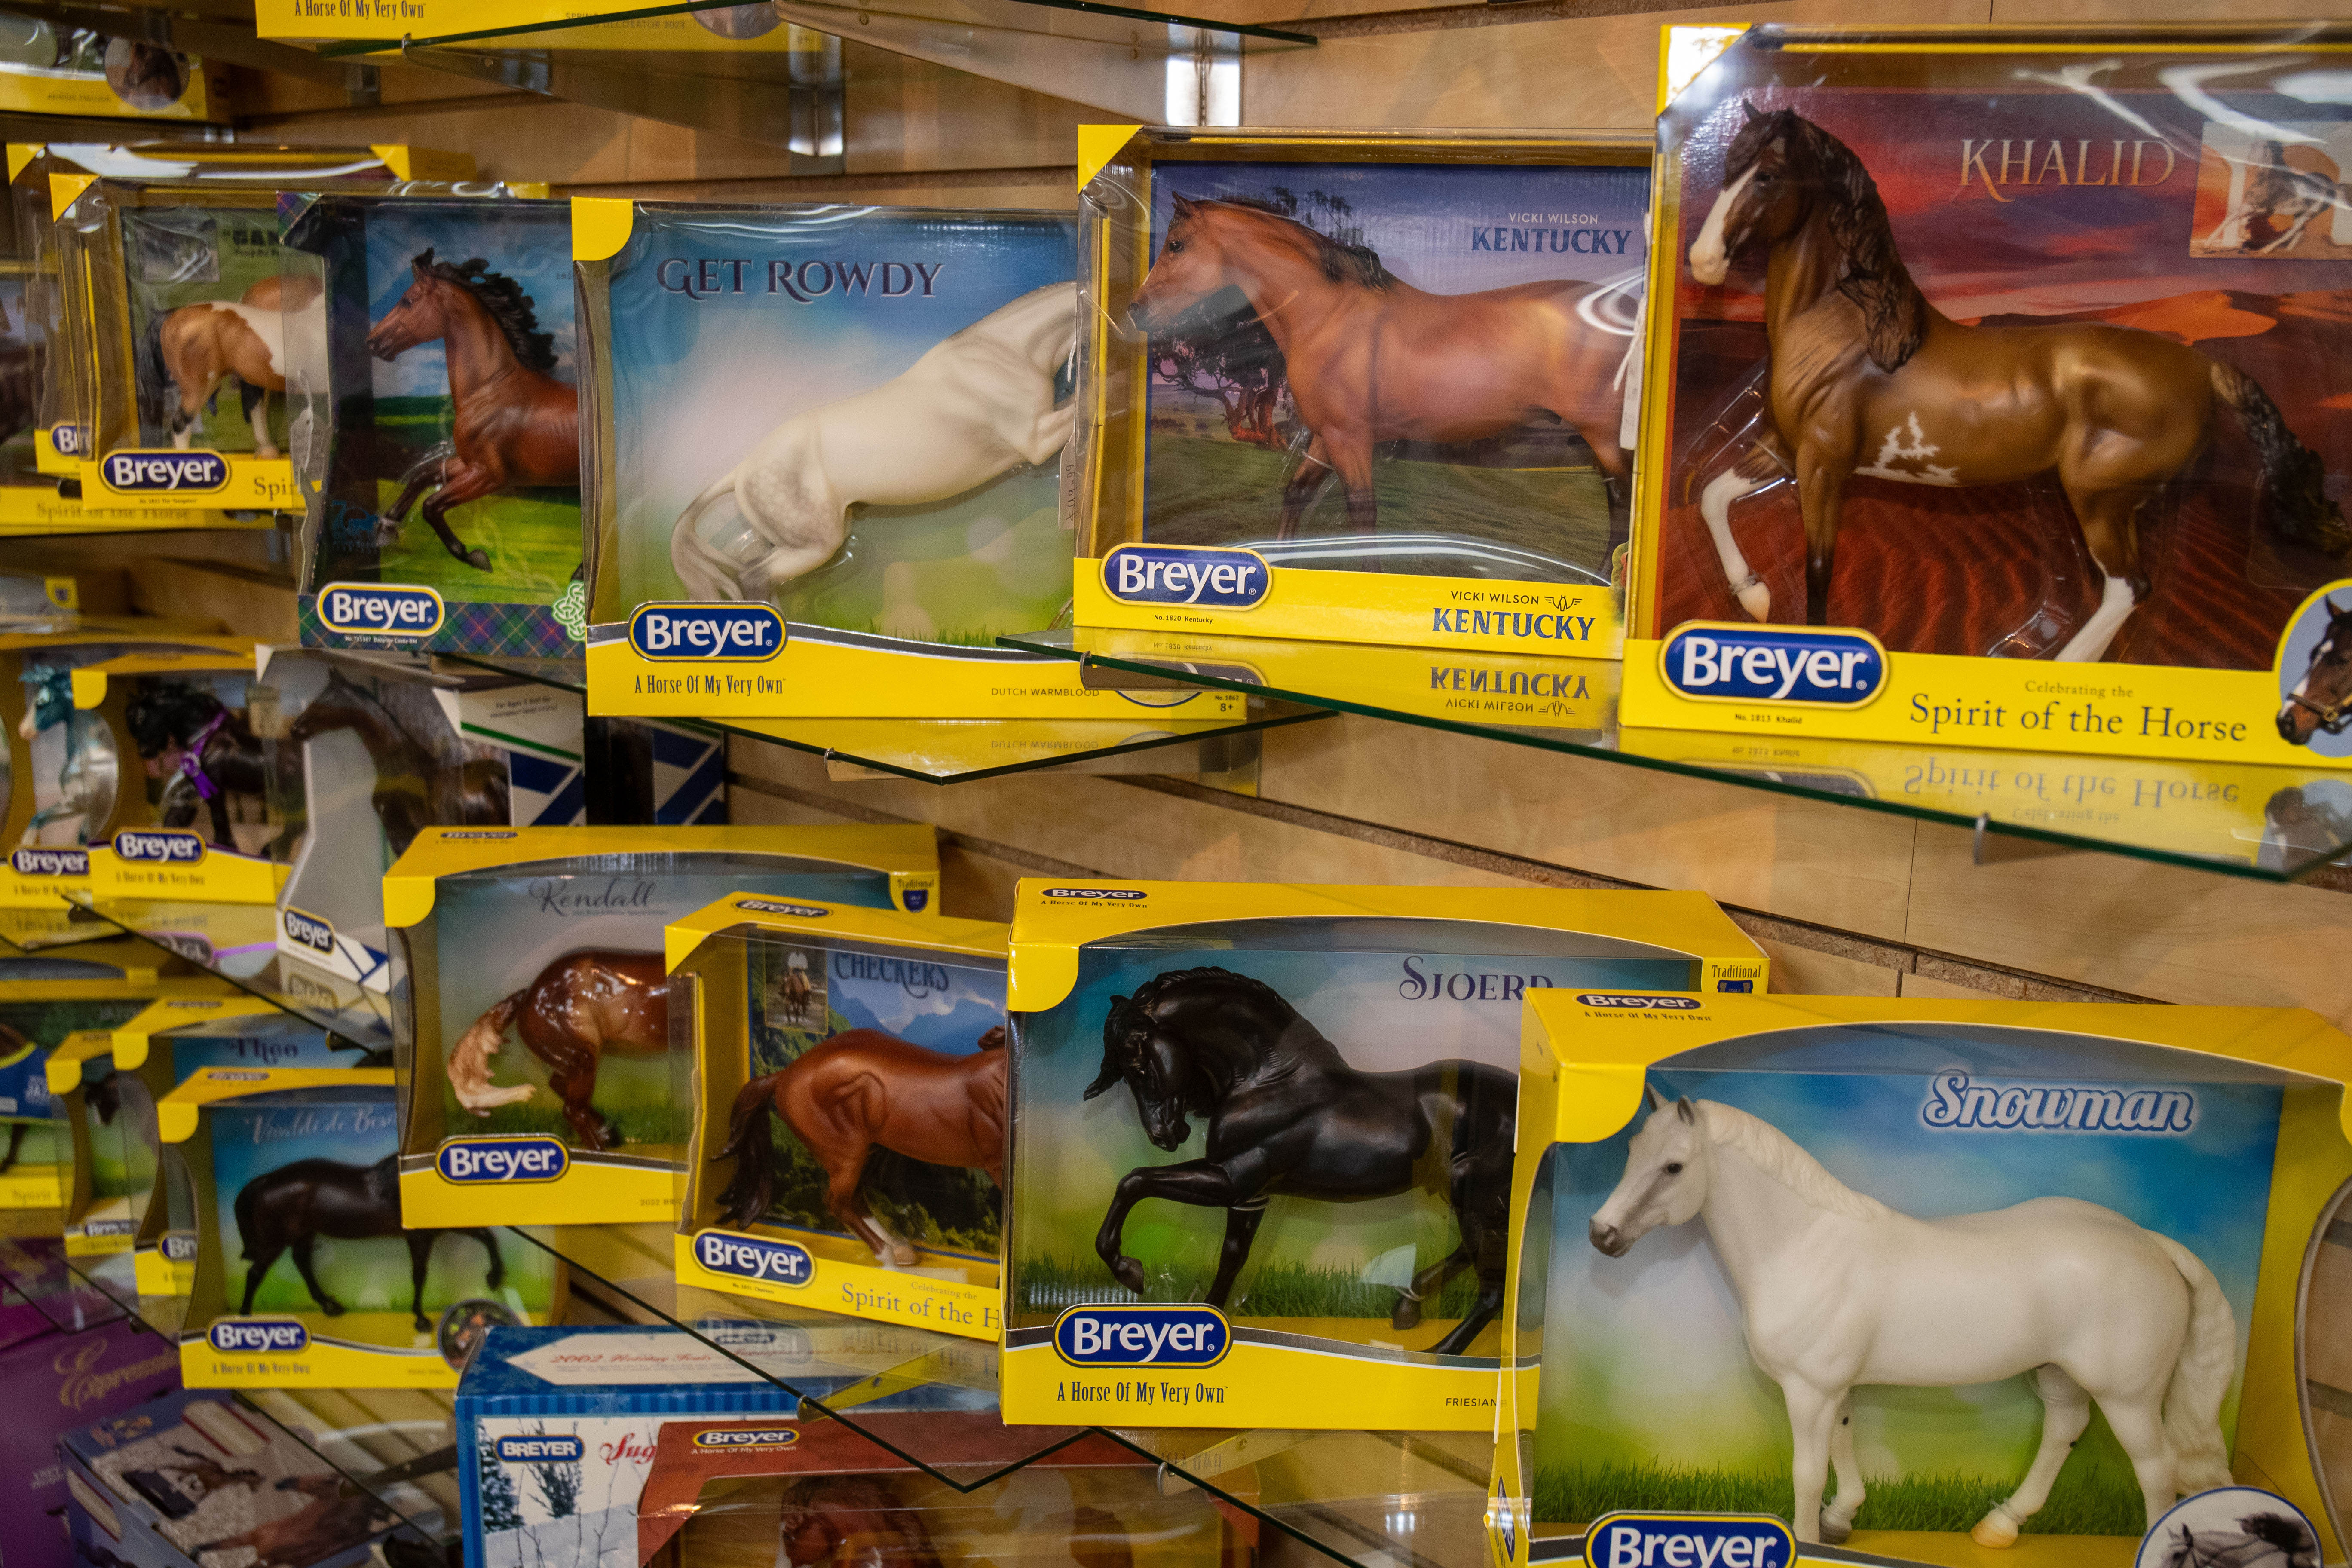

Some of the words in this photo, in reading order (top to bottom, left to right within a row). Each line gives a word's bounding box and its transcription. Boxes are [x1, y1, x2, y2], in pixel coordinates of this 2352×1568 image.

[295, 0, 301, 16] A
[306, 0, 336, 17] Horse
[340, 0, 350, 17] Of
[355, 0, 370, 20] My
[374, 0, 396, 20] Very
[401, 0, 424, 18] Own
[1951, 138, 2176, 202] KHALID
[1509, 212, 1544, 224] VICKI
[1547, 213, 1599, 225] WILSON
[1471, 226, 1632, 255] KENTUCKY
[657, 258, 753, 302] GET
[766, 259, 945, 304] ROWDY
[113, 456, 218, 489] Breyer
[1118, 554, 1256, 603] Breyer
[1451, 591, 1485, 602] VICKI
[1489, 593, 1539, 605] WILSON
[333, 592, 432, 630] Breyer
[1185, 616, 1213, 624] Kentucky
[646, 614, 771, 658] Breyer
[1432, 607, 1596, 641] KENTUCKY
[1681, 636, 1869, 699] Breyer
[635, 676, 643, 694] A
[647, 676, 682, 694] Horse
[686, 676, 700, 694] Of
[705, 675, 722, 697] My
[726, 675, 753, 696] Very
[757, 675, 783, 694] Own
[991, 688, 1027, 696] DUTCH
[1031, 688, 1099, 697] WARMBLOOD
[2025, 680, 2105, 700] Celebrating
[2111, 685, 2133, 698] the
[1220, 703, 1234, 712] 8+
[1776, 715, 1803, 724] Khalid
[1910, 693, 2007, 734] Spirit
[2020, 701, 2060, 730] of
[2070, 704, 2123, 734] the
[2139, 705, 2247, 742] Horse
[121, 833, 198, 863] Breyer
[16, 851, 88, 876] Breyer
[529, 875, 656, 917] Kendall
[1052, 889, 1139, 899] Breyer
[741, 900, 824, 916] Breyer
[835, 951, 949, 999] CHECKERS
[1712, 965, 1761, 978] Traditional
[1586, 995, 1690, 1009] Breyer
[1923, 1069, 2195, 1132] Snowman
[449, 1147, 557, 1182] Breyer
[703, 1236, 803, 1278] Breyer
[754, 1286, 774, 1295] Checkers
[911, 1281, 961, 1296] Celebrating
[963, 1289, 977, 1300] the
[841, 1283, 900, 1312] Spirit
[909, 1297, 931, 1317] of
[939, 1302, 973, 1325] the
[217, 1323, 301, 1353] Breyer
[1073, 1317, 1216, 1363] Breyer
[550, 1354, 603, 1363] 2002
[1057, 1382, 1066, 1401] A
[1071, 1381, 1111, 1402] Horse
[1116, 1381, 1132, 1402] Of
[1136, 1381, 1155, 1405] My
[1161, 1382, 1190, 1406] Very
[1195, 1382, 1225, 1403] Own
[1446, 1398, 1497, 1407] FRIESIAN
[502, 1440, 576, 1457] BREYER
[704, 1430, 790, 1446] Breyer
[1608, 1527, 1778, 1568] Breyer
